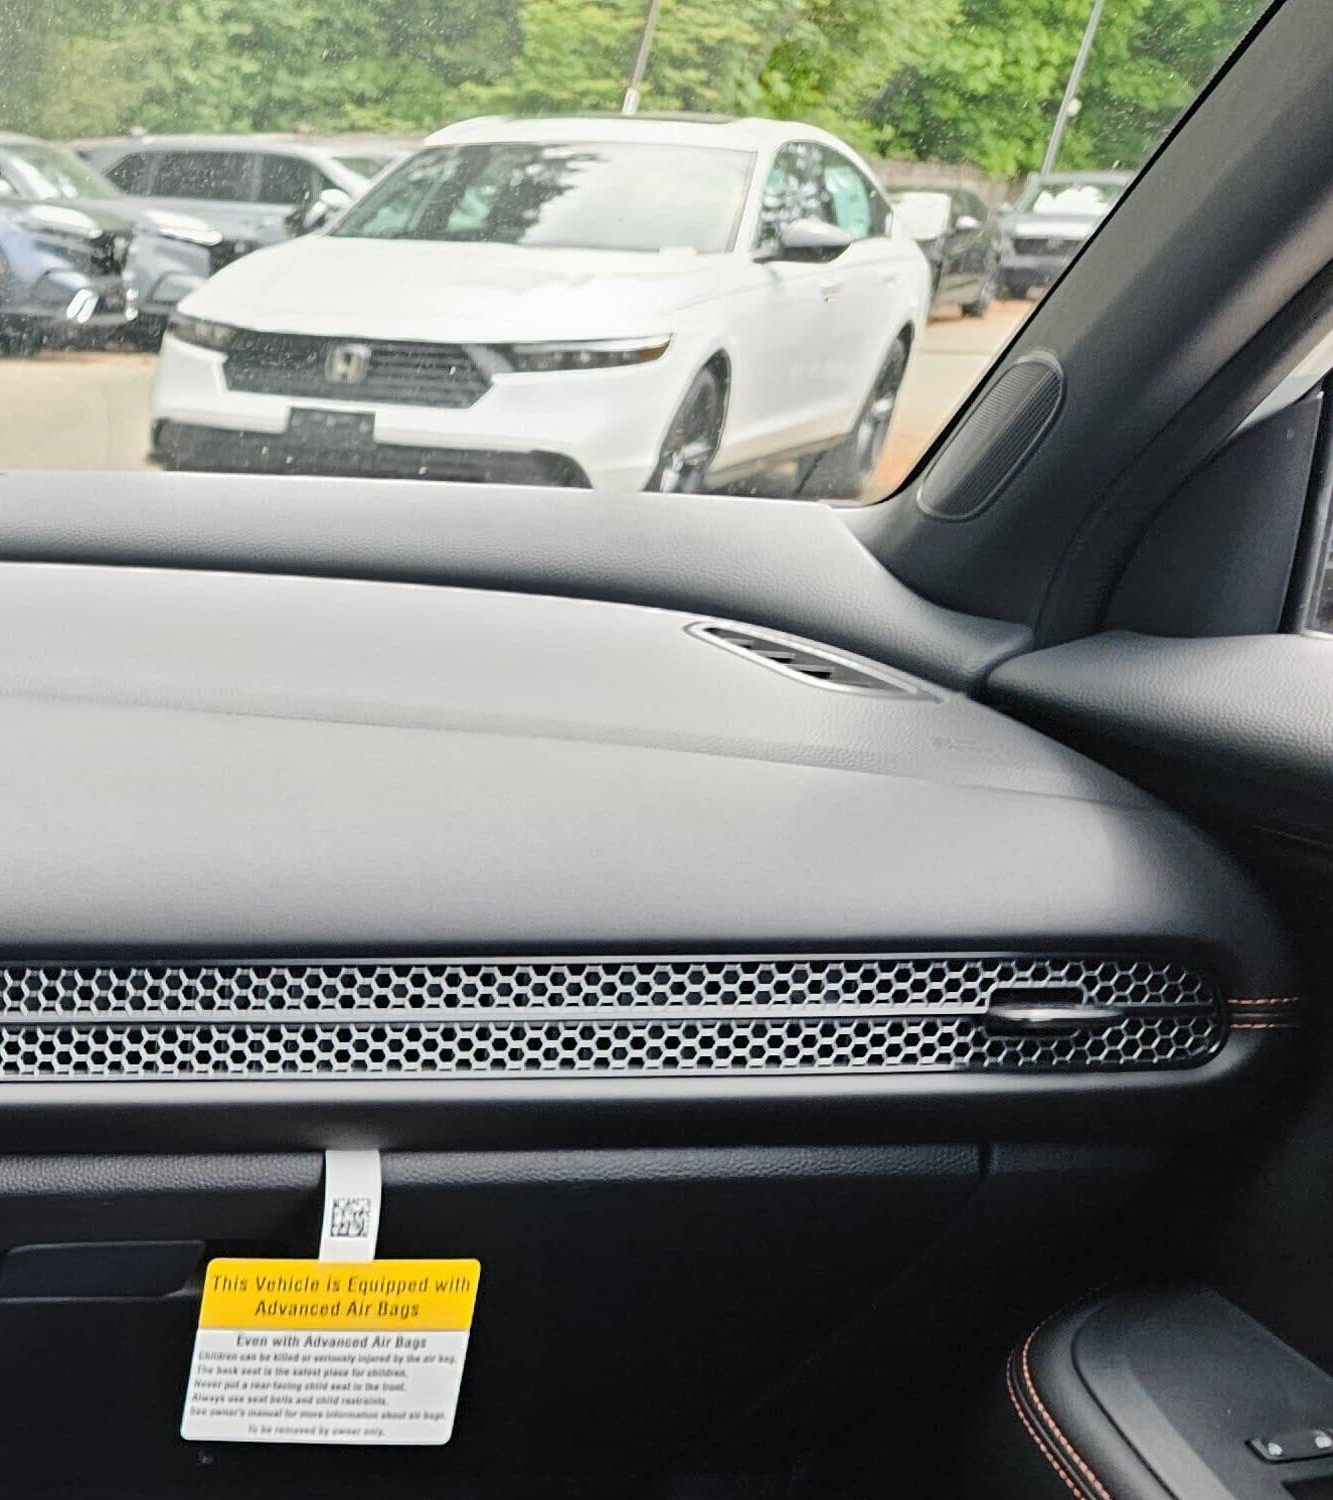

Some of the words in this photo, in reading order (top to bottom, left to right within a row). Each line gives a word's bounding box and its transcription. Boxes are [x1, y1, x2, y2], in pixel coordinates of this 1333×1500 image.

[213, 1275, 247, 1292] This
[256, 1275, 320, 1292] Vehicle
[326, 1275, 340, 1292] is
[347, 1275, 429, 1296] Equipped
[435, 1275, 471, 1292] with
[254, 1300, 341, 1316] Advanced
[347, 1301, 372, 1316] Air
[378, 1301, 420, 1320] Bags
[236, 1334, 268, 1347] Even
[273, 1335, 300, 1347] with
[304, 1335, 368, 1348] Advanced
[371, 1336, 390, 1348] Air
[395, 1336, 427, 1351] Bags
